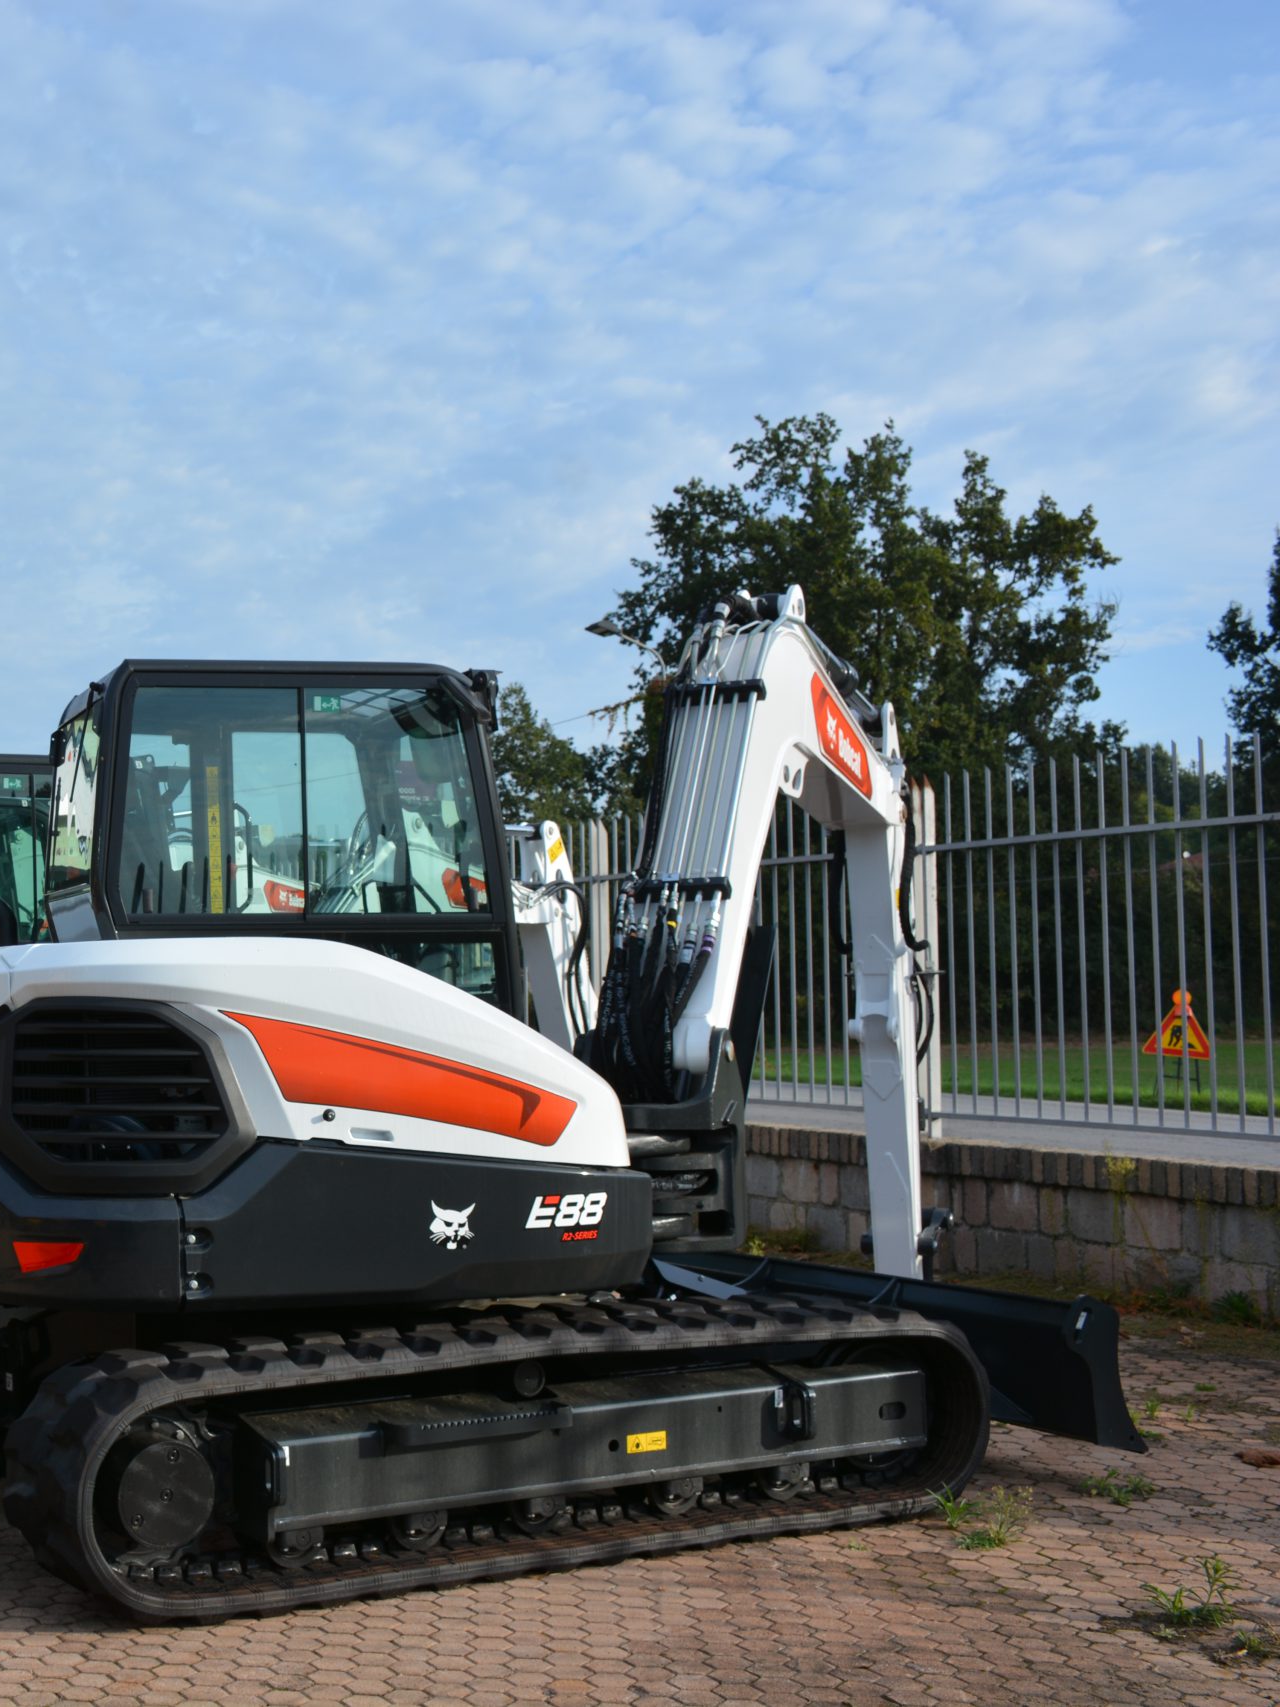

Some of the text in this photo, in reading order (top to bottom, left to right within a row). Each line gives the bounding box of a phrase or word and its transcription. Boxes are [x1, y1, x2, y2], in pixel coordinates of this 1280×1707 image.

[838, 727, 863, 780] Bobcat
[525, 1192, 608, 1229] E88
[562, 1229, 598, 1242] R2-SERIES
